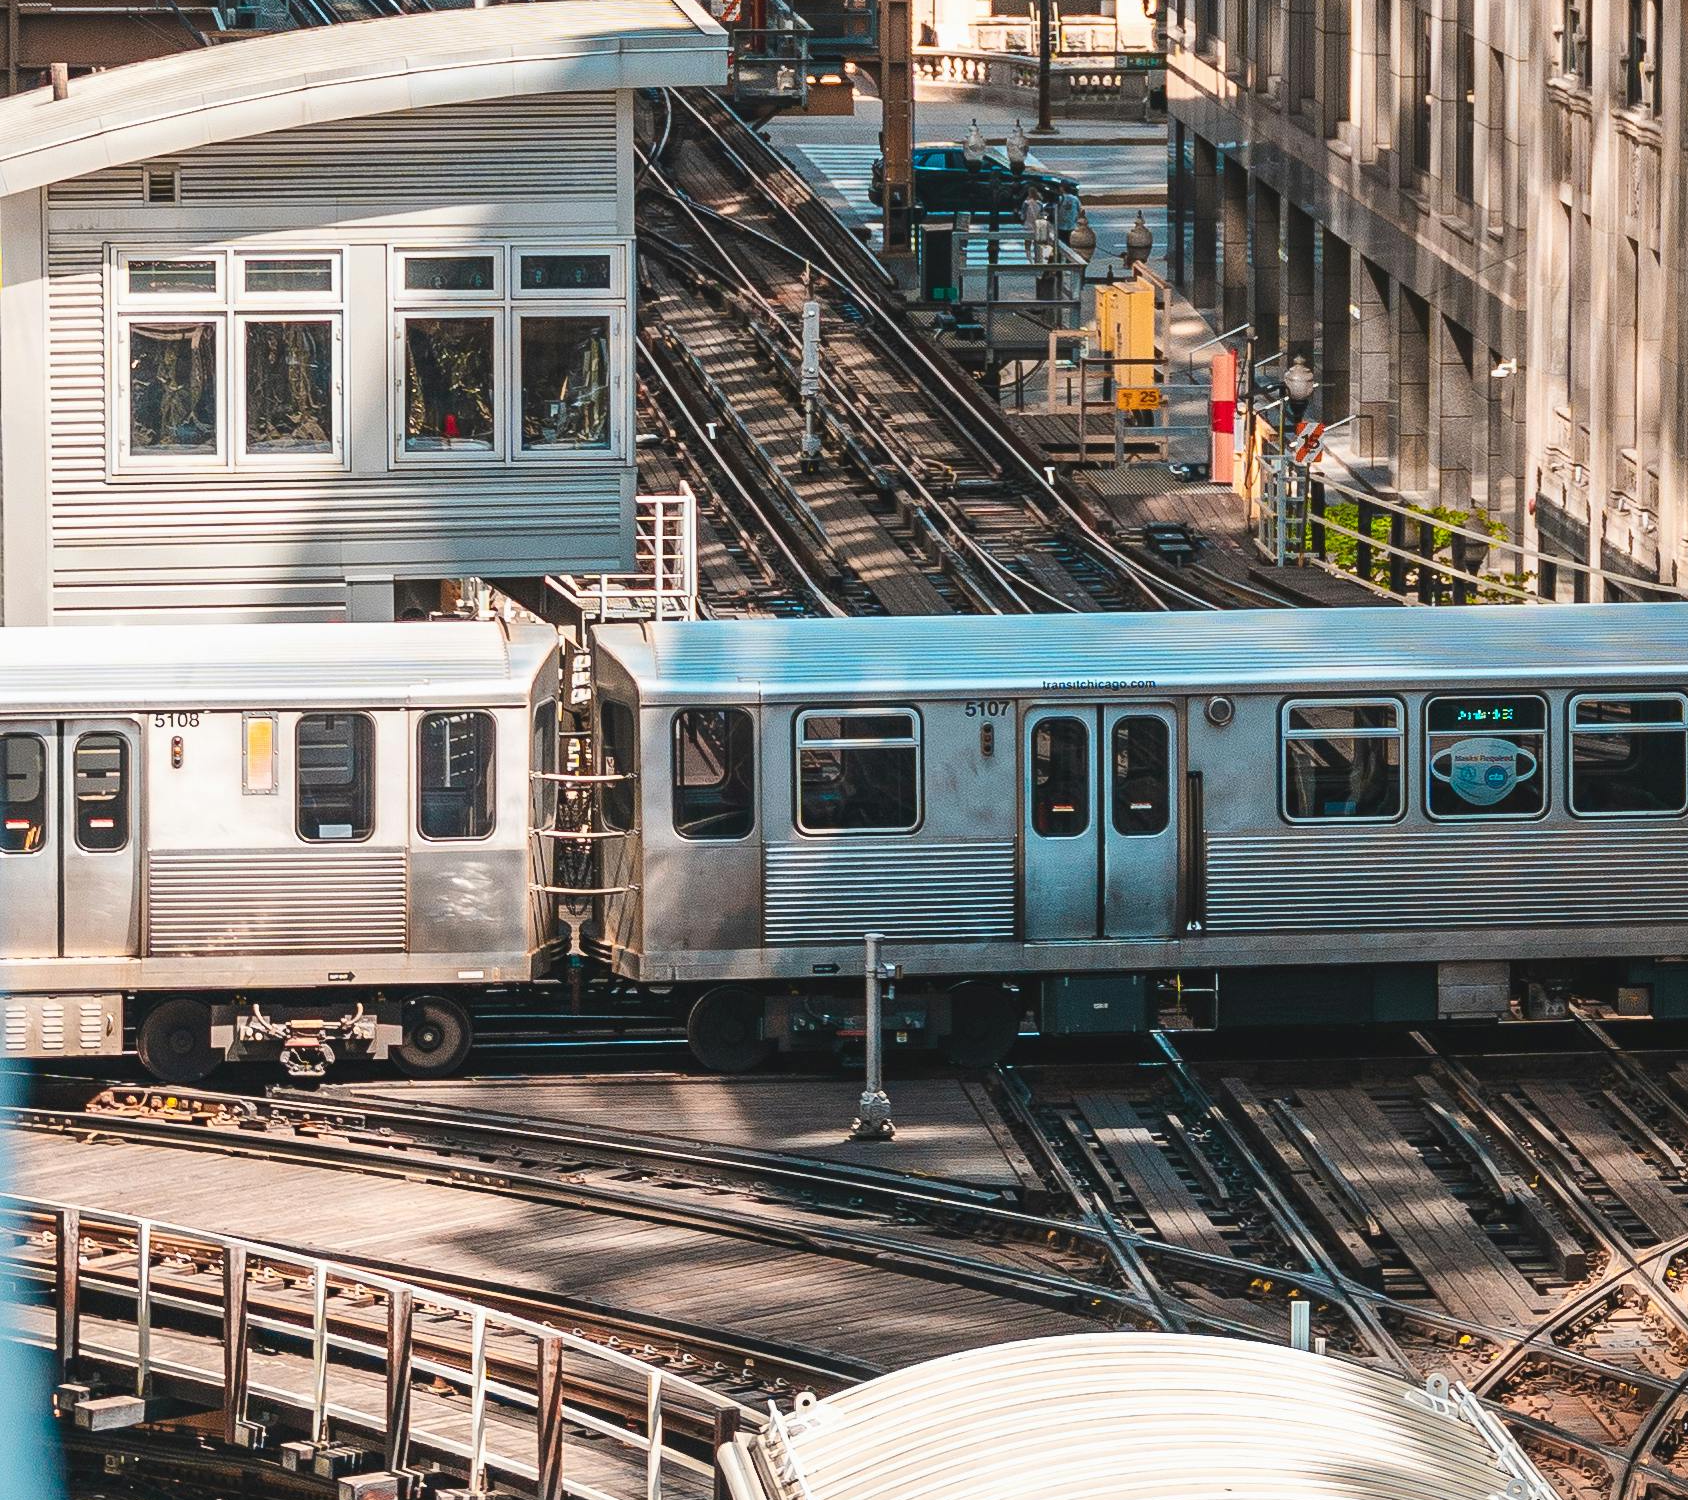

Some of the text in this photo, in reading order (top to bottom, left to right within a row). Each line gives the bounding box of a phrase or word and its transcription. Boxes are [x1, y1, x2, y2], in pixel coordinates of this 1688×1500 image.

[1140, 390, 1157, 403] 25
[1042, 678, 1157, 692] transitchicago.com
[964, 701, 1011, 717] 5107
[154, 712, 200, 728] 5108
